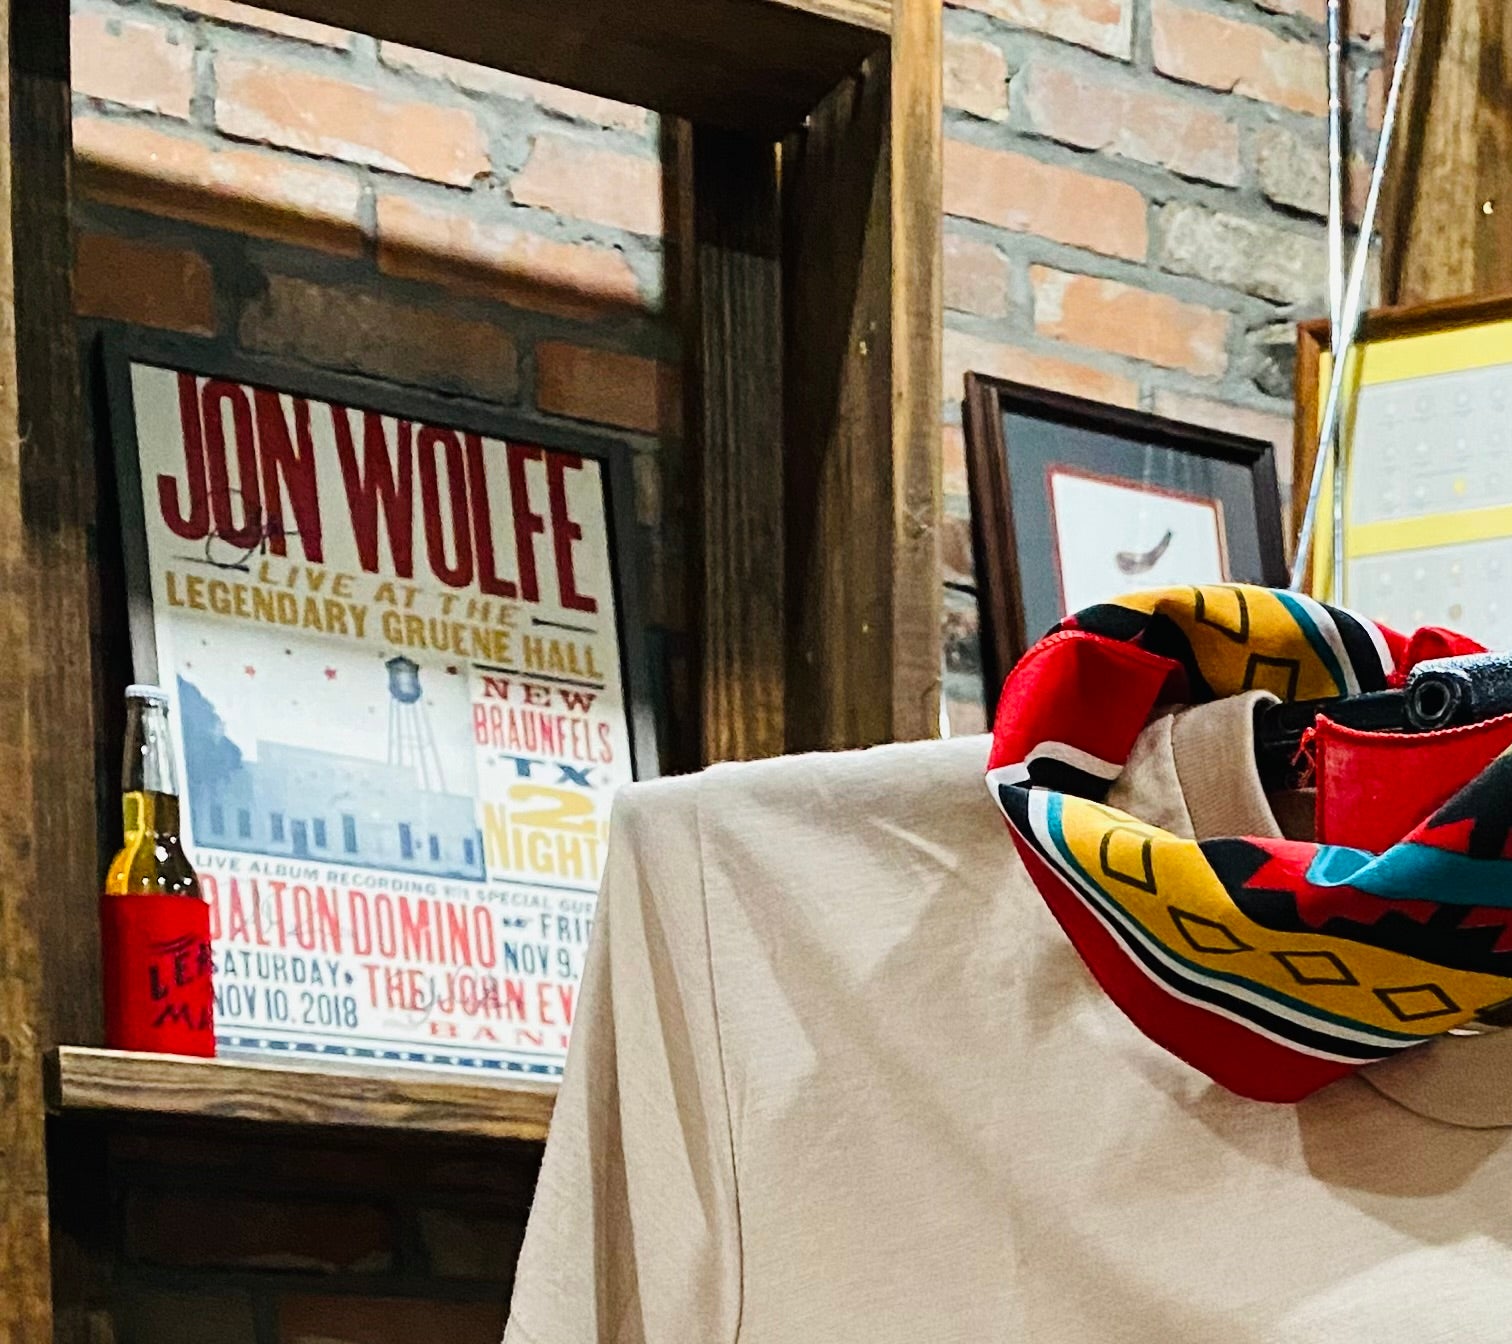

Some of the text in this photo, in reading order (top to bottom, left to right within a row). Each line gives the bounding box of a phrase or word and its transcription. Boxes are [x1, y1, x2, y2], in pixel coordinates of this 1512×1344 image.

[157, 370, 324, 563] JON
[330, 404, 599, 613] WOLFE
[258, 560, 522, 628] LIVE AT THE
[165, 570, 604, 680] LEGENDARY GRUENE HALL
[481, 675, 597, 714] NEW
[473, 702, 613, 764] BRAUNFELS
[499, 754, 596, 789] TX
[507, 783, 596, 833] 2
[195, 854, 240, 872] LIVE
[249, 860, 319, 882] ALBUM
[326, 870, 437, 896] RECORDING
[477, 889, 552, 912] SPECIAL
[198, 872, 497, 969] DALTON DOMINO
[504, 940, 551, 975] NOV
[213, 982, 257, 1021] NOV
[301, 990, 359, 1030] 2018
[361, 964, 428, 1012] THE
[437, 971, 528, 1023] JOHN
